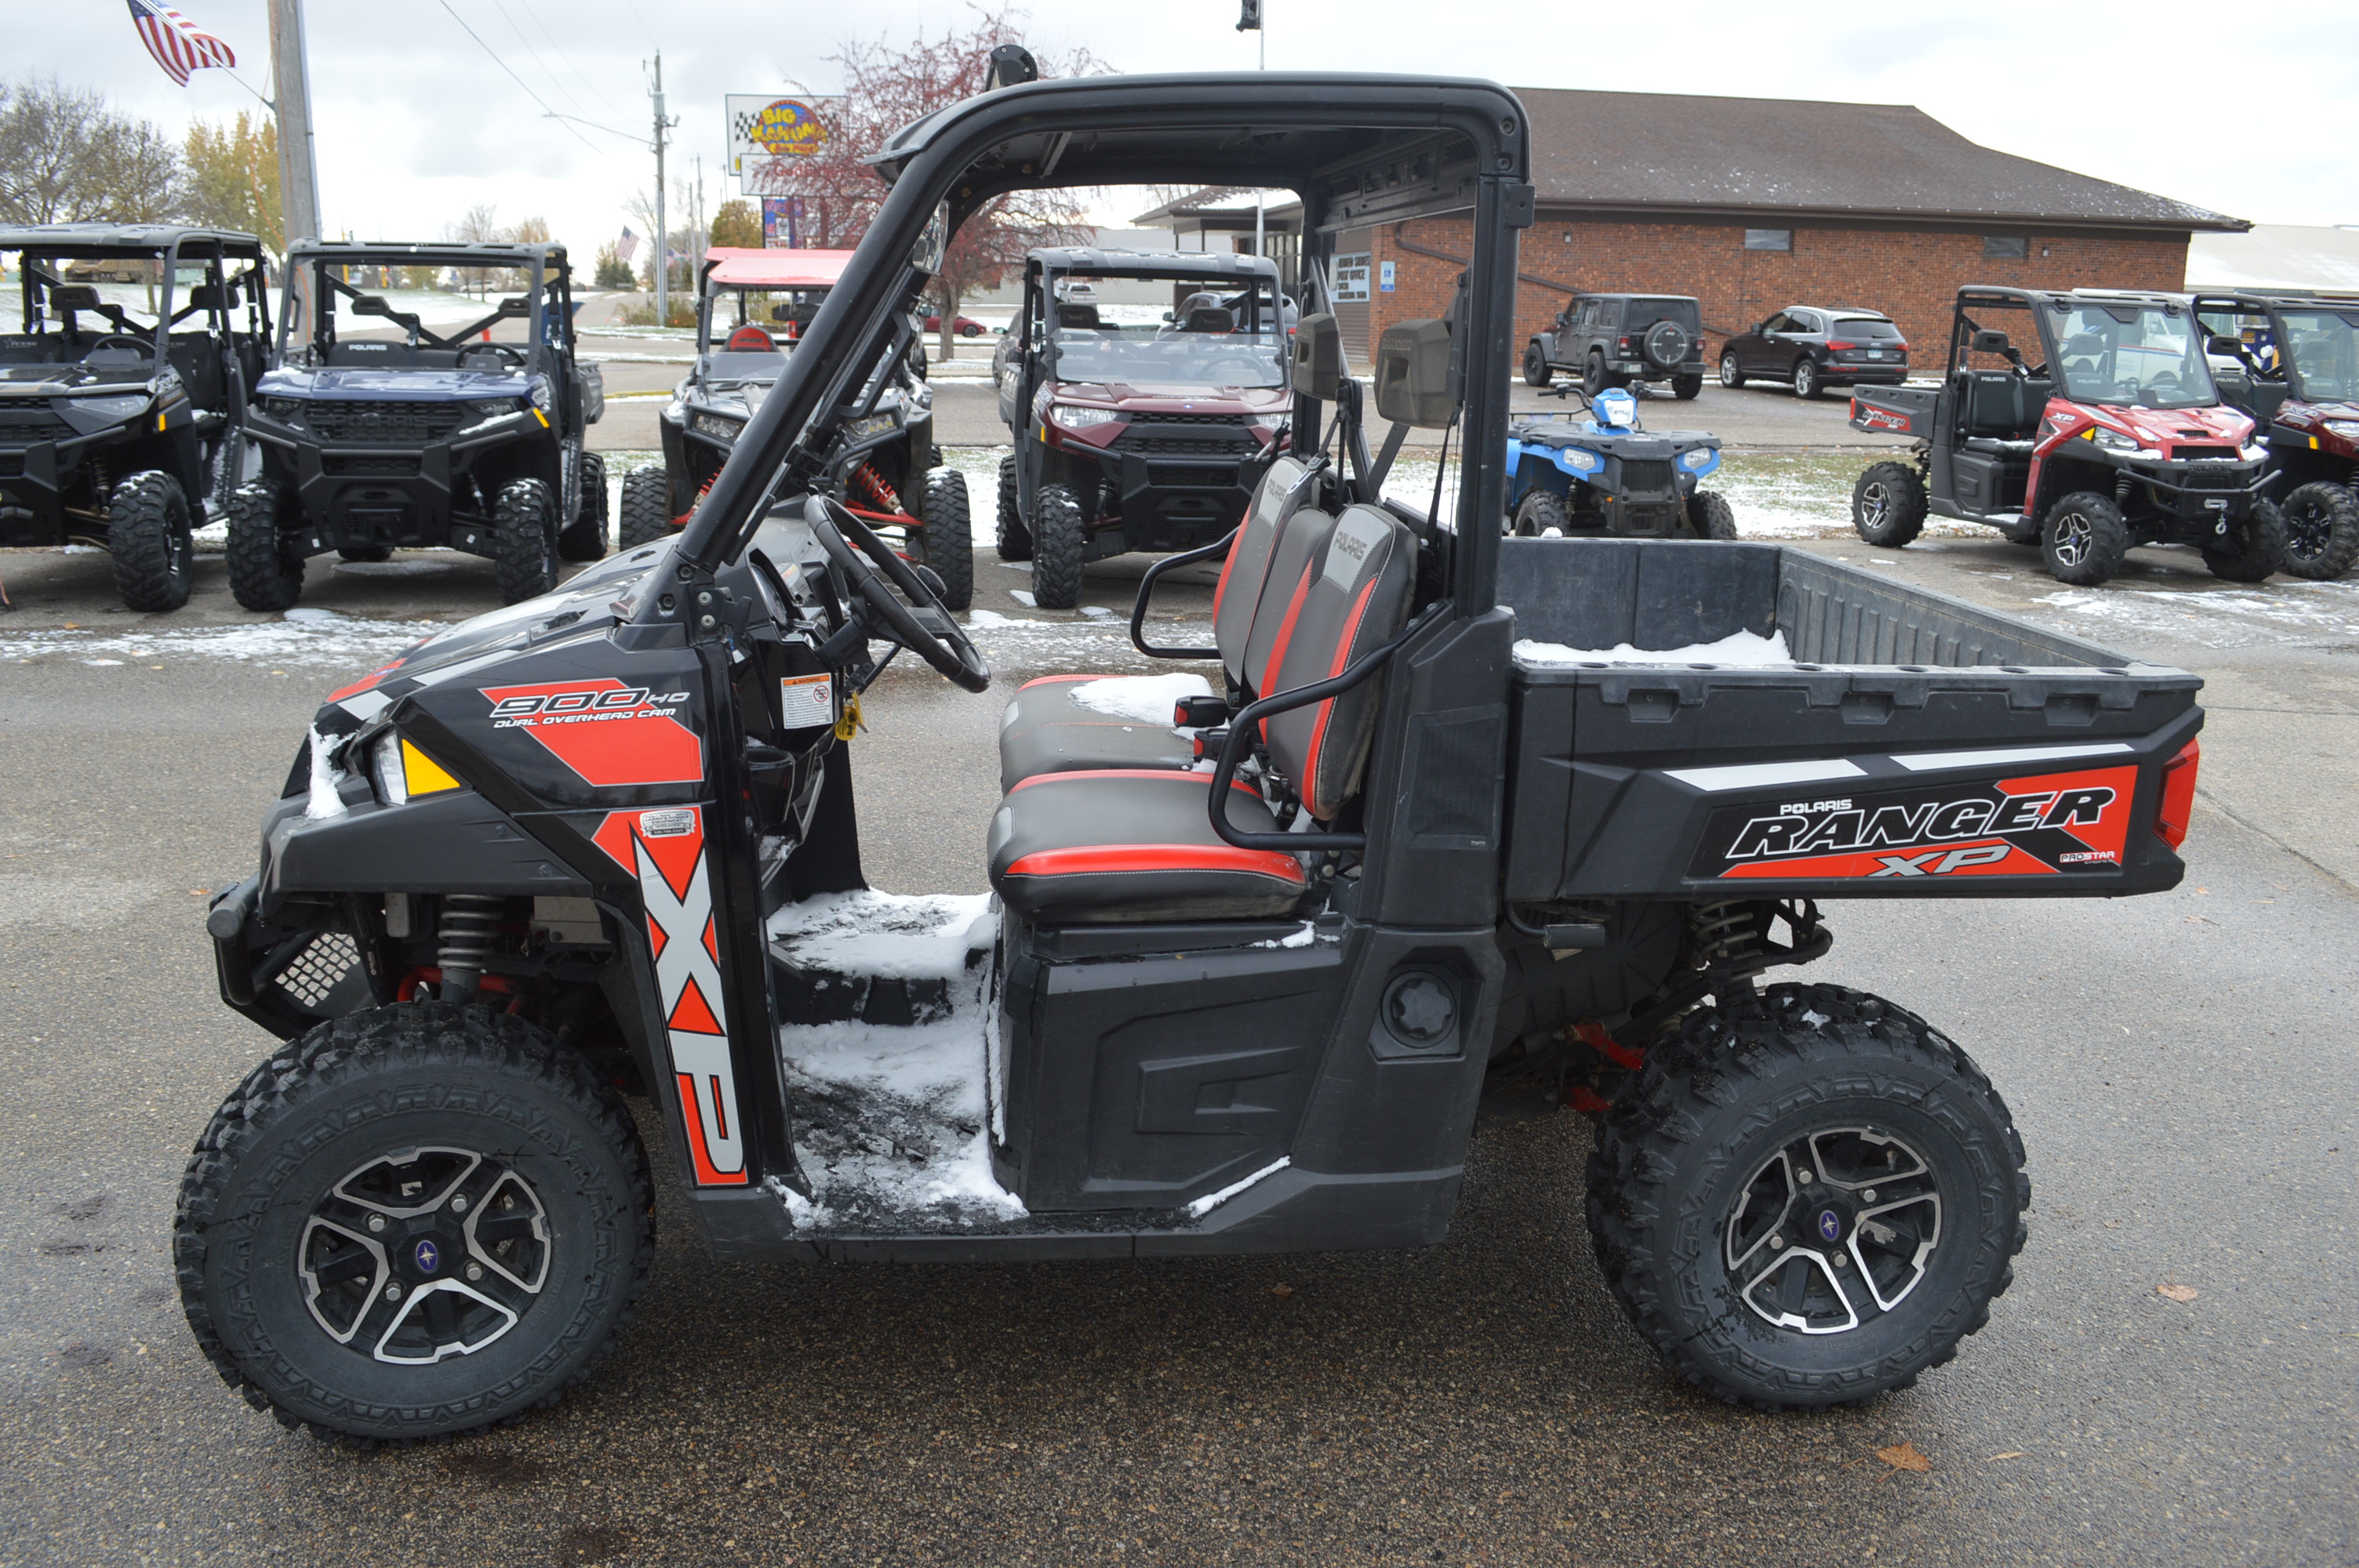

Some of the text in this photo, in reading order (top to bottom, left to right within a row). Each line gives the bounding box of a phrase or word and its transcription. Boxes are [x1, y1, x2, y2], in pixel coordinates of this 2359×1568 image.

[761, 107, 797, 125] BIG
[1862, 410, 1906, 426] RANGER
[2051, 412, 2077, 422] XP
[1267, 478, 1288, 503] POLARIS
[1333, 530, 1368, 561] POLARIS
[489, 687, 691, 718] 900 HO
[493, 708, 677, 728] DUAL OVERHEAD CAM
[1779, 798, 1852, 815] POLARIS
[1725, 786, 2117, 859] RANGER
[1865, 843, 2013, 877] XP
[2060, 851, 2115, 863] PROSTAR
[632, 833, 746, 1174] XP
